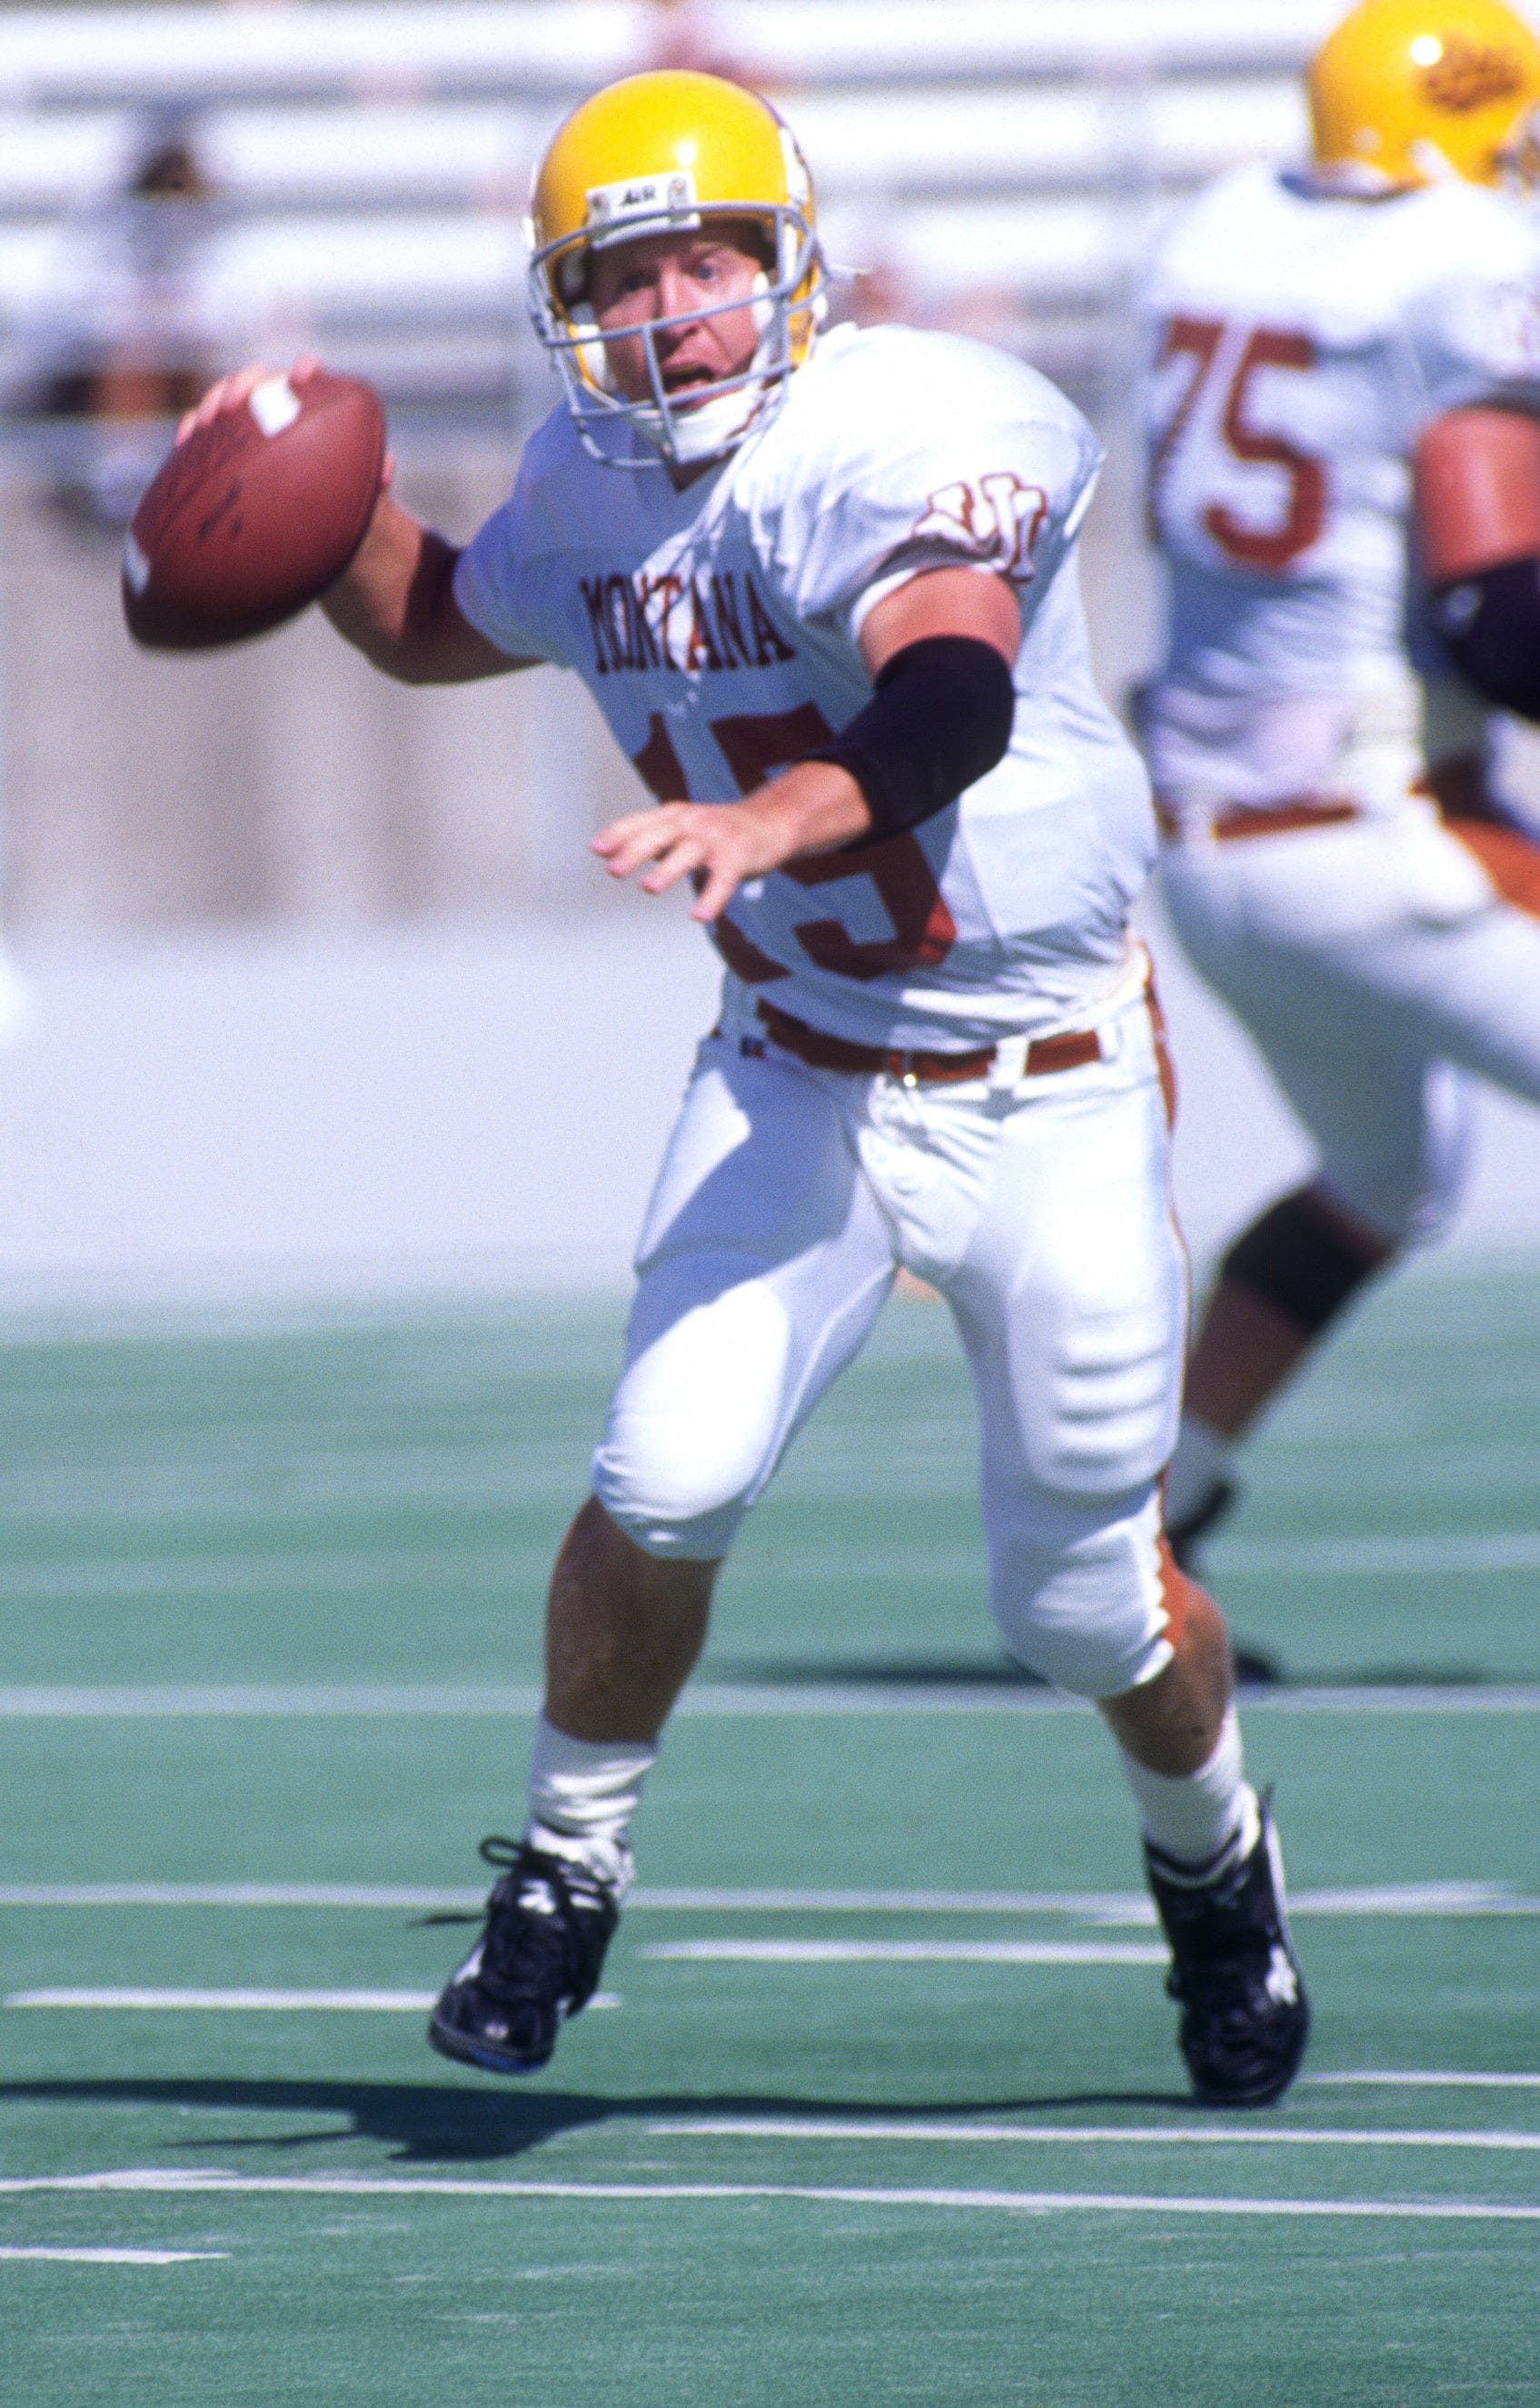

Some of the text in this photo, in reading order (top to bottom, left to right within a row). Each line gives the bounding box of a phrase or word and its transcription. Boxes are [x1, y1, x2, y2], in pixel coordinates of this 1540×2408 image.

[1148, 314, 1328, 578] 75
[579, 570, 797, 675] MONTANA
[632, 702, 959, 985] 15
